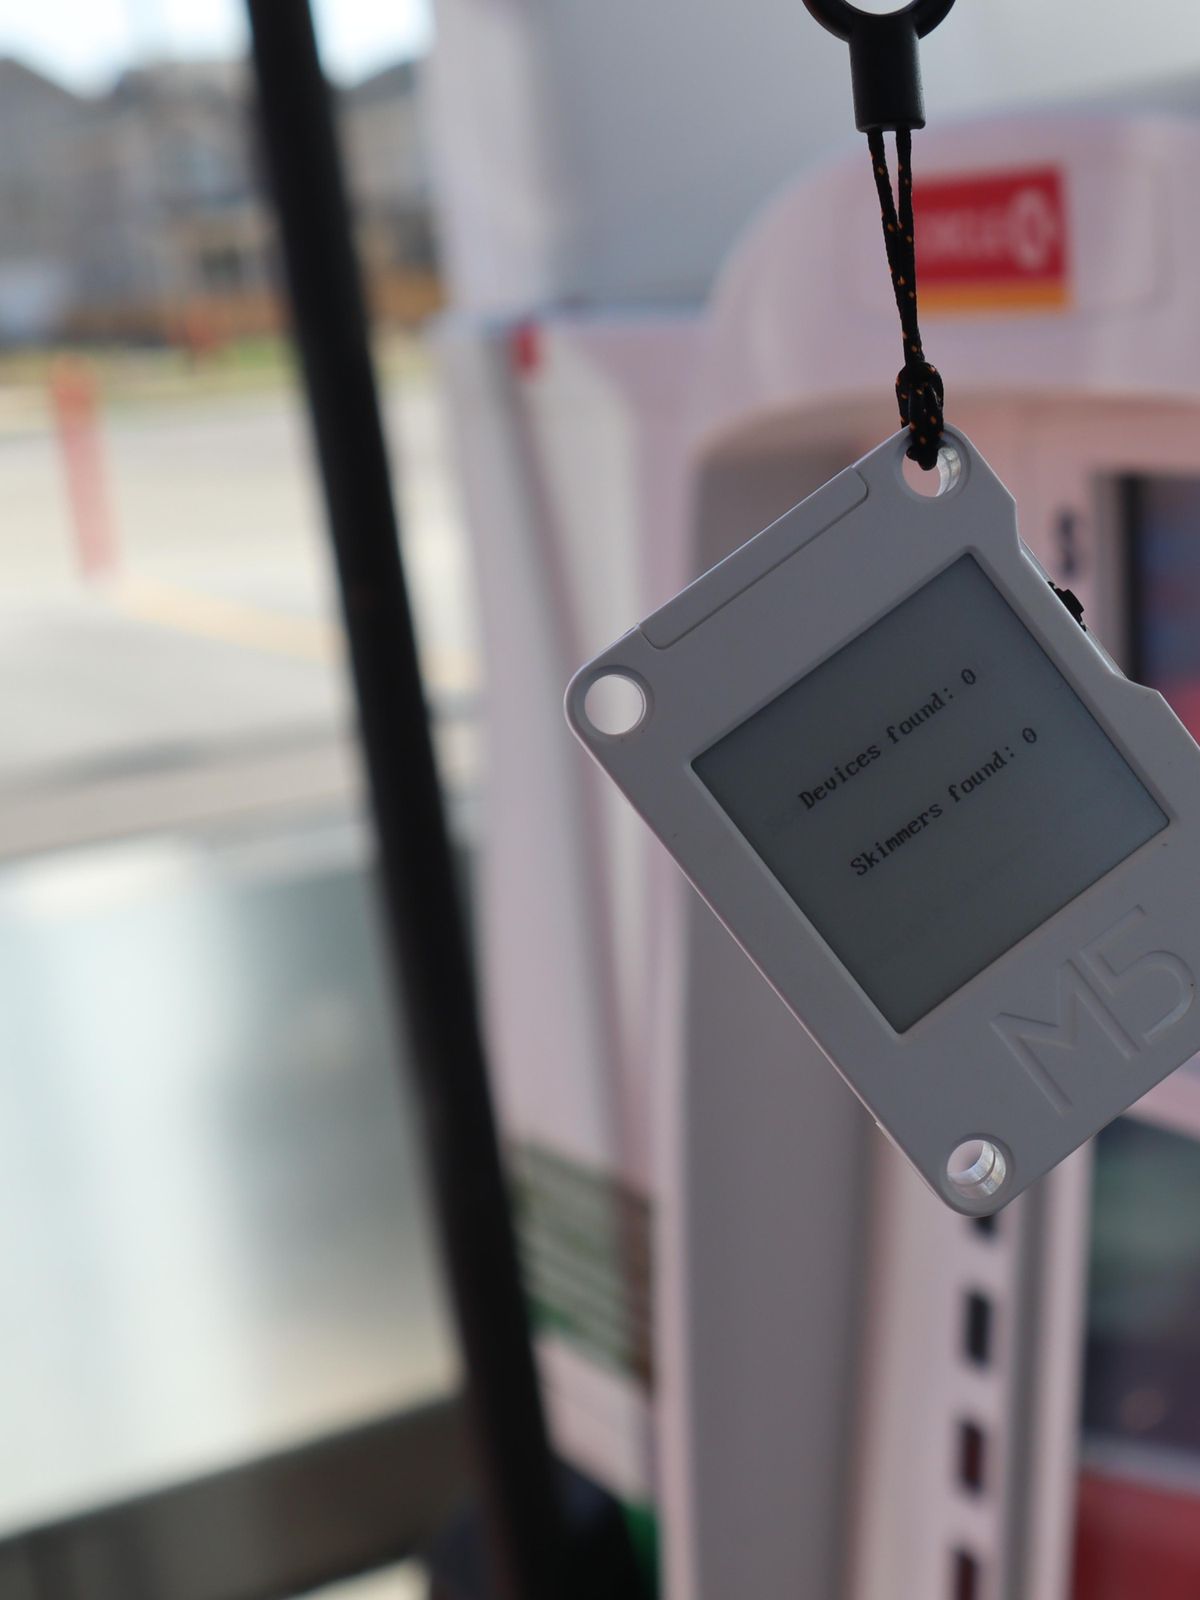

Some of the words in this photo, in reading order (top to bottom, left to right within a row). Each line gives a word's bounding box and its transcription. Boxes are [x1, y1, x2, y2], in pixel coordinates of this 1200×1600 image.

[797, 742, 882, 811] Devices
[886, 686, 954, 745] found:
[960, 667, 977, 686] 0
[849, 801, 944, 878] Skimmers
[947, 745, 1016, 804] found:
[1021, 726, 1038, 745] 0
[988, 904, 1196, 1119] M5
